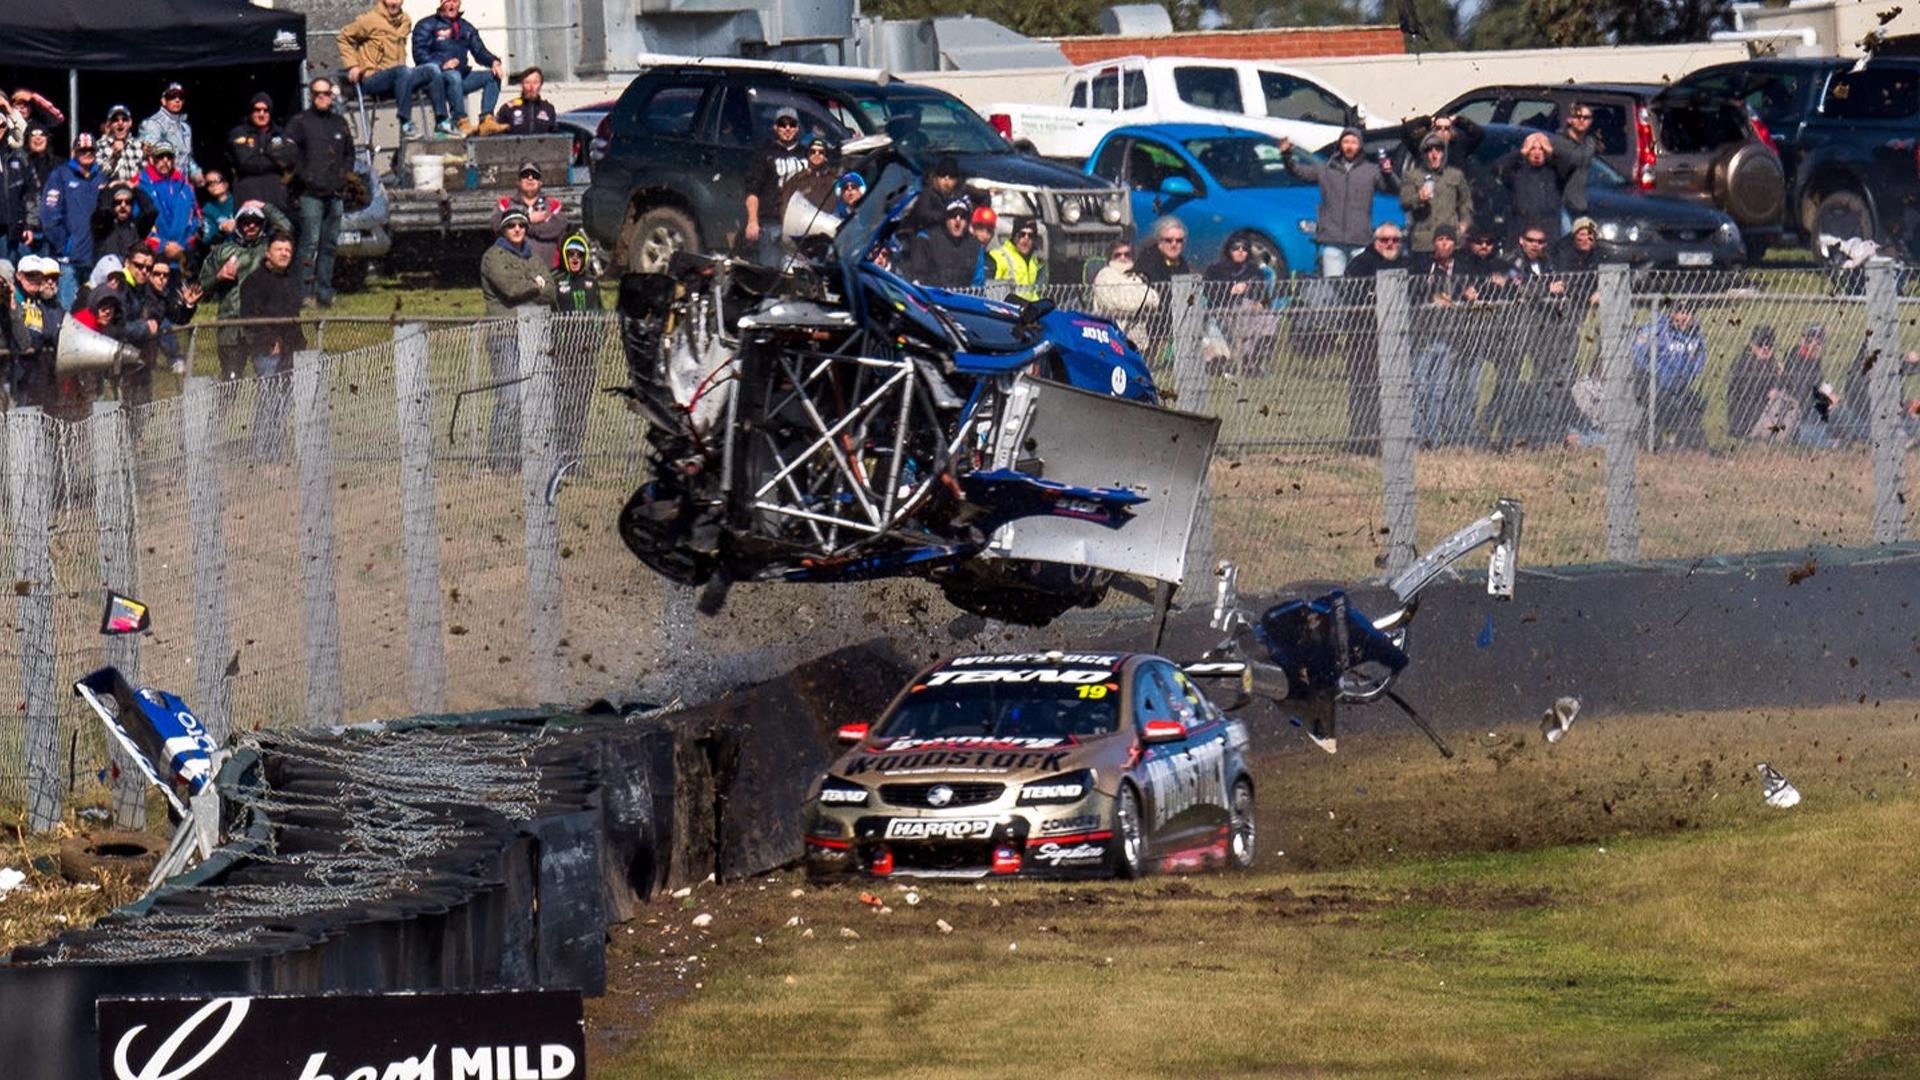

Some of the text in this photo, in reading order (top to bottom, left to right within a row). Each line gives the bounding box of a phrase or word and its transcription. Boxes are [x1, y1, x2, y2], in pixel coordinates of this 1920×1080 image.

[951, 653, 1119, 666] WOODSOCK
[926, 669, 1113, 687] TEKNO
[1075, 685, 1108, 699] 19
[844, 751, 1070, 776] WOODSTOCK
[1021, 784, 1083, 799] TEKNO
[893, 821, 987, 836] HARROP
[451, 1044, 576, 1080] MILD
